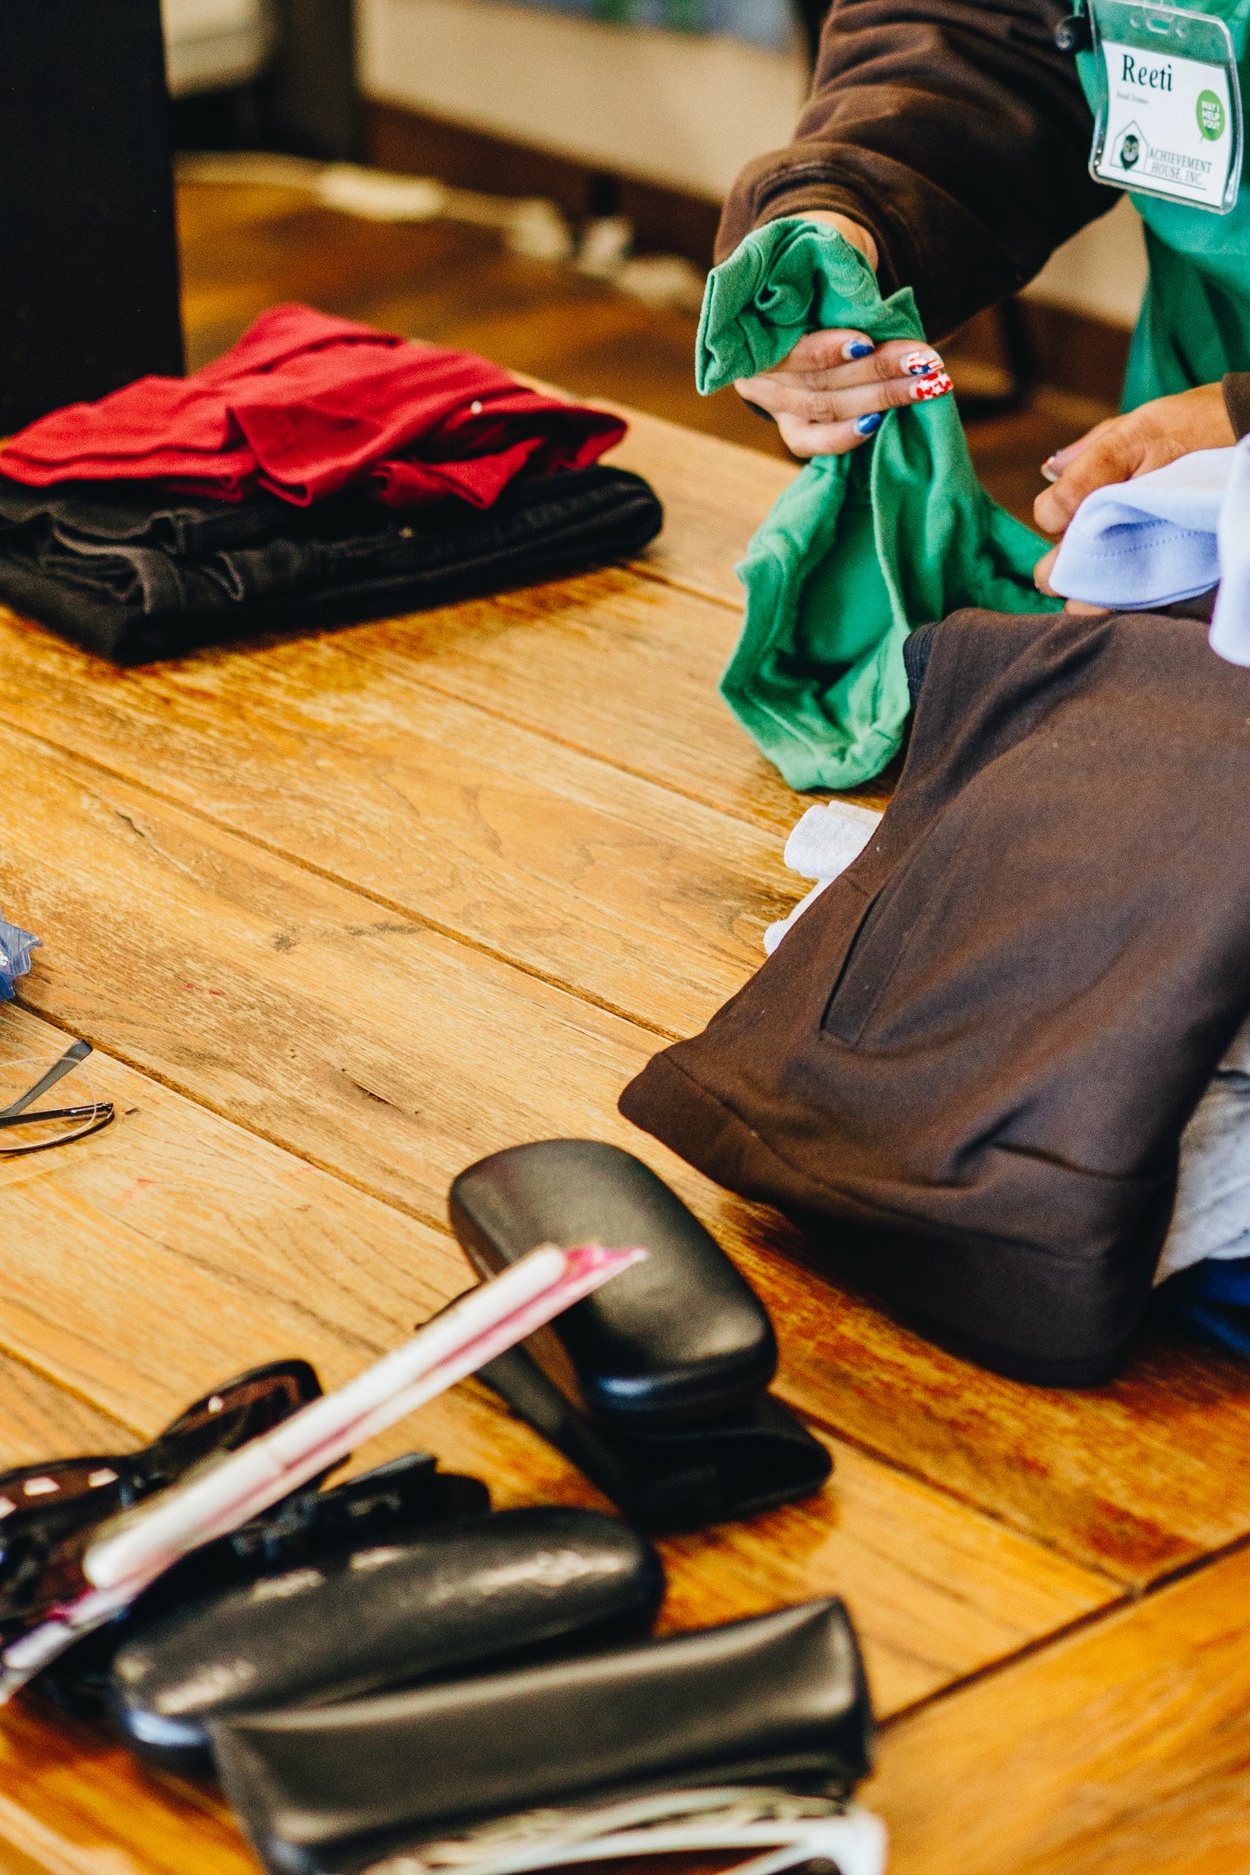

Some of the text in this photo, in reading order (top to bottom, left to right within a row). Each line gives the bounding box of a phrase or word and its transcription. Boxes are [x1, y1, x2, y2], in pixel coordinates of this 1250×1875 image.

[1121, 54, 1172, 92] Reeti
[1150, 147, 1212, 174] ACHIEVEMENT
[1152, 162, 1182, 181] HOUSE,
